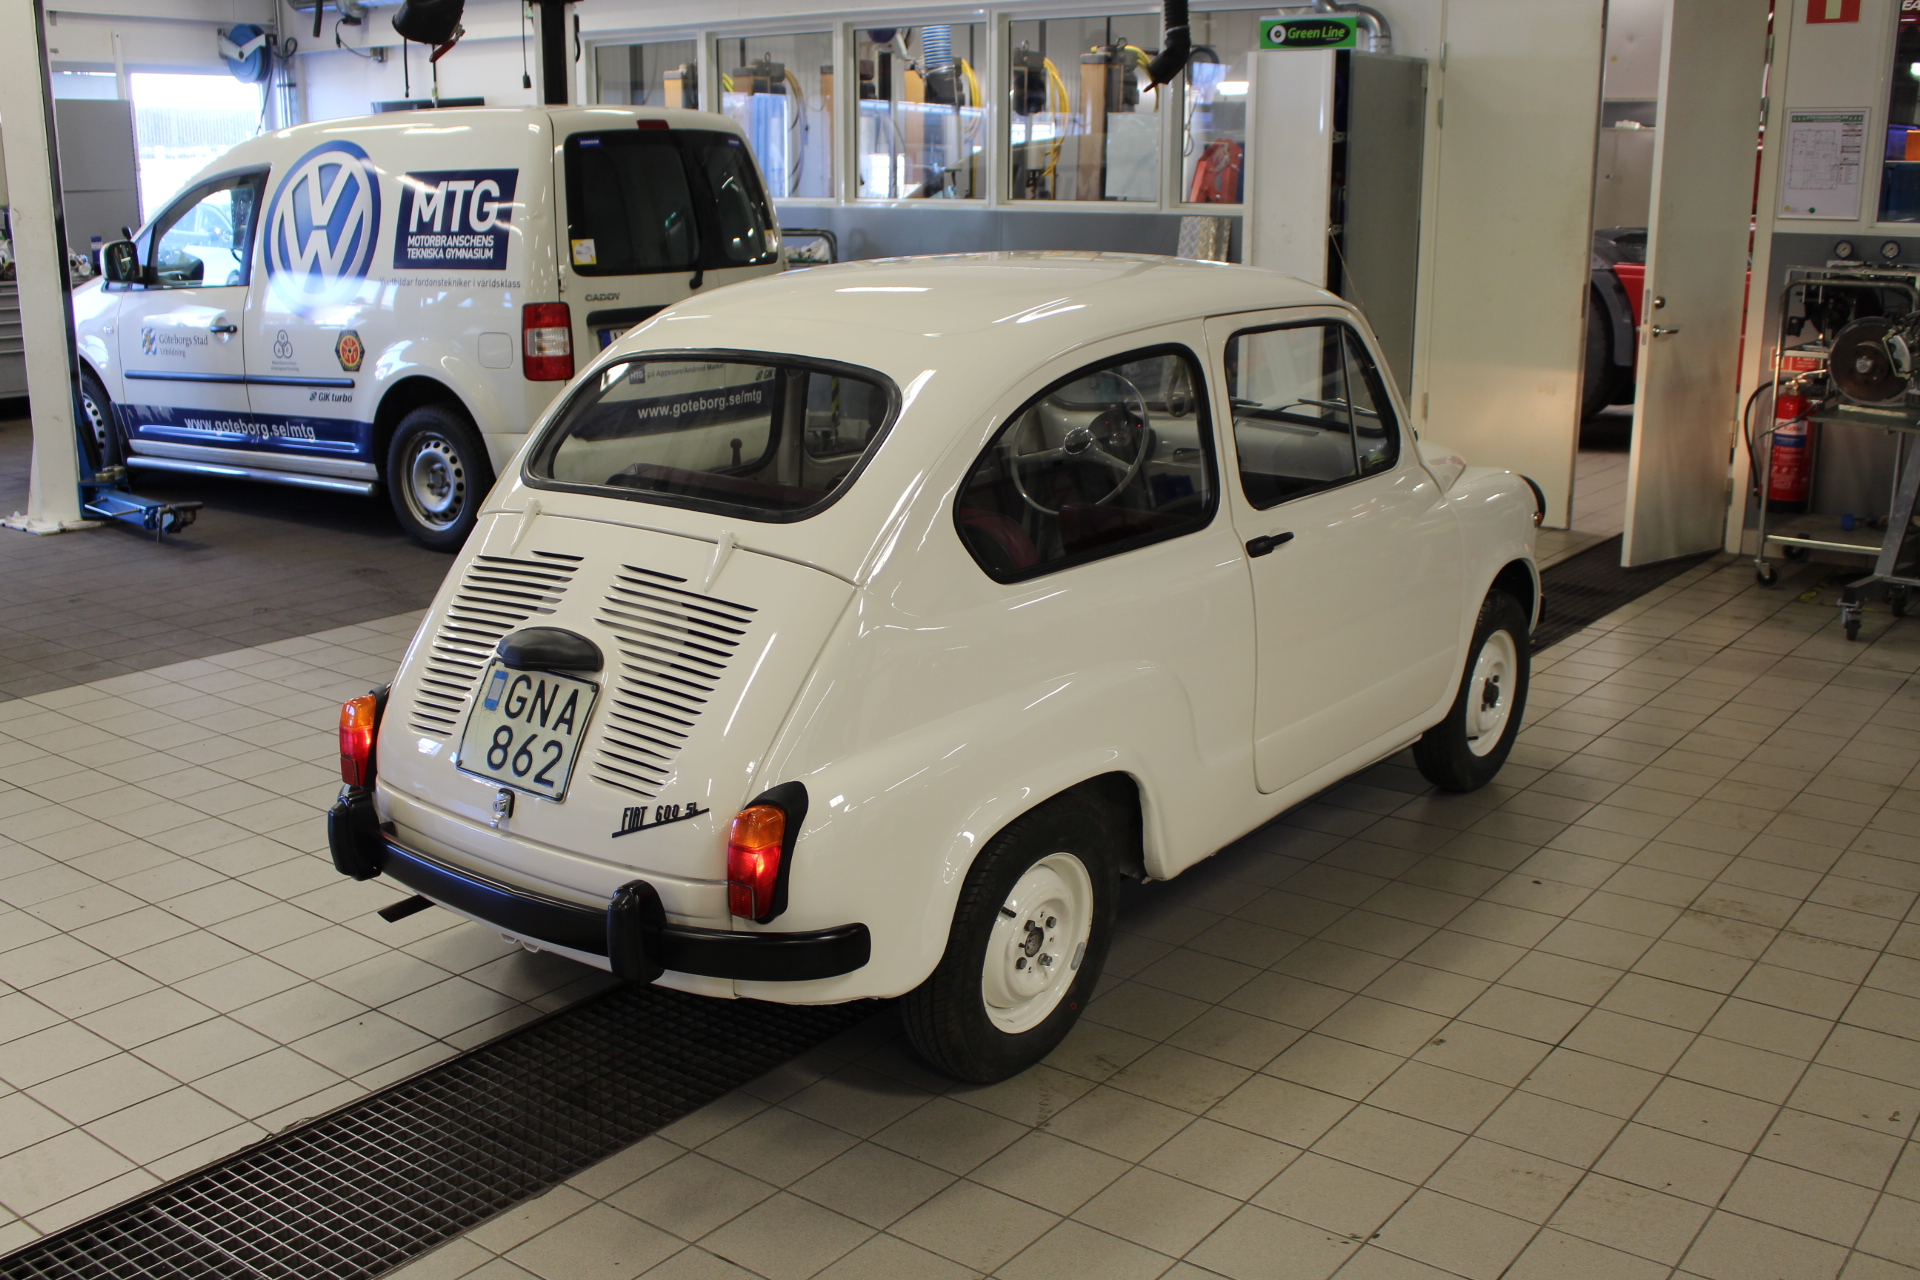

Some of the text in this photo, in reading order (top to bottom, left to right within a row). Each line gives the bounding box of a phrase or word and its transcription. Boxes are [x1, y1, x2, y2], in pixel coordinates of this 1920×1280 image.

[1287, 26, 1345, 38] Green Line
[408, 179, 501, 233] MTG
[407, 235, 494, 248] MOTORBRANSCHENS
[407, 247, 494, 260] TEKNISKA GYMNASIUM
[415, 277, 472, 288] fordonstekniker
[477, 278, 522, 289] världsklass
[585, 292, 621, 302] CADDY
[159, 333, 209, 348] Göteborgs Stad
[331, 392, 353, 403] turbo
[638, 387, 763, 419] www.goteborg.se/mtg
[184, 417, 316, 443] www.goteborg.se/mtg
[504, 674, 579, 736] GNA
[486, 725, 563, 788] 862
[621, 805, 649, 831] FIAT
[655, 804, 680, 823] 600
